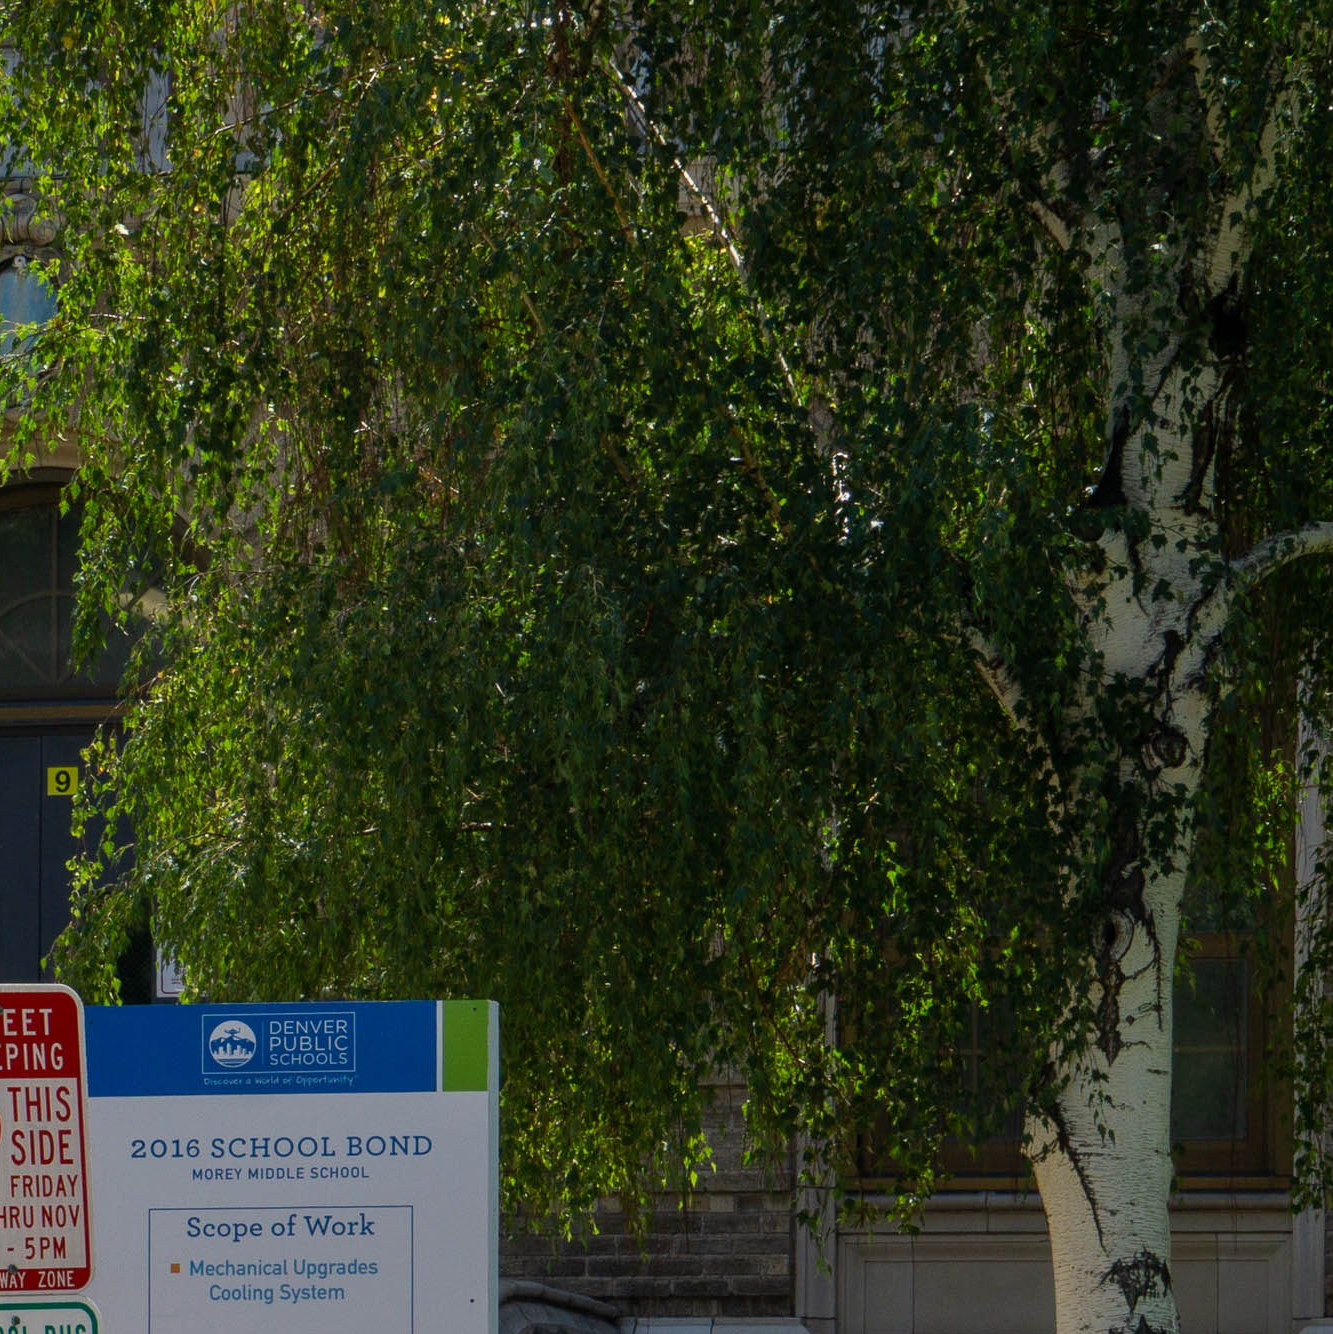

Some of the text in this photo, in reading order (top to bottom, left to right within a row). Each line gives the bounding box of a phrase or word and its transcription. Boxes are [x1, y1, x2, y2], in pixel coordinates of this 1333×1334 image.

[54, 769, 71, 793] 9
[269, 1020, 348, 1035] DENVER
[269, 1035, 349, 1052] PUBLIC
[269, 1052, 348, 1066] SCHOOLS
[203, 1077, 242, 1086] Discover
[7, 1086, 71, 1122] THIS
[11, 1129, 74, 1166] SIDE
[131, 1135, 433, 1159] 2016 SCHOOL BOND
[192, 1166, 369, 1181] MOREY MIDDLE SCHOOL
[10, 1174, 78, 1198] FRIDAY
[41, 1204, 80, 1228] NOV
[186, 1213, 375, 1243] Scope of Work
[24, 1236, 67, 1260] 5PM
[38, 1270, 75, 1288] ZONE
[189, 1258, 379, 1279] Mechanical Upgrades
[209, 1283, 345, 1304] Cooling System
